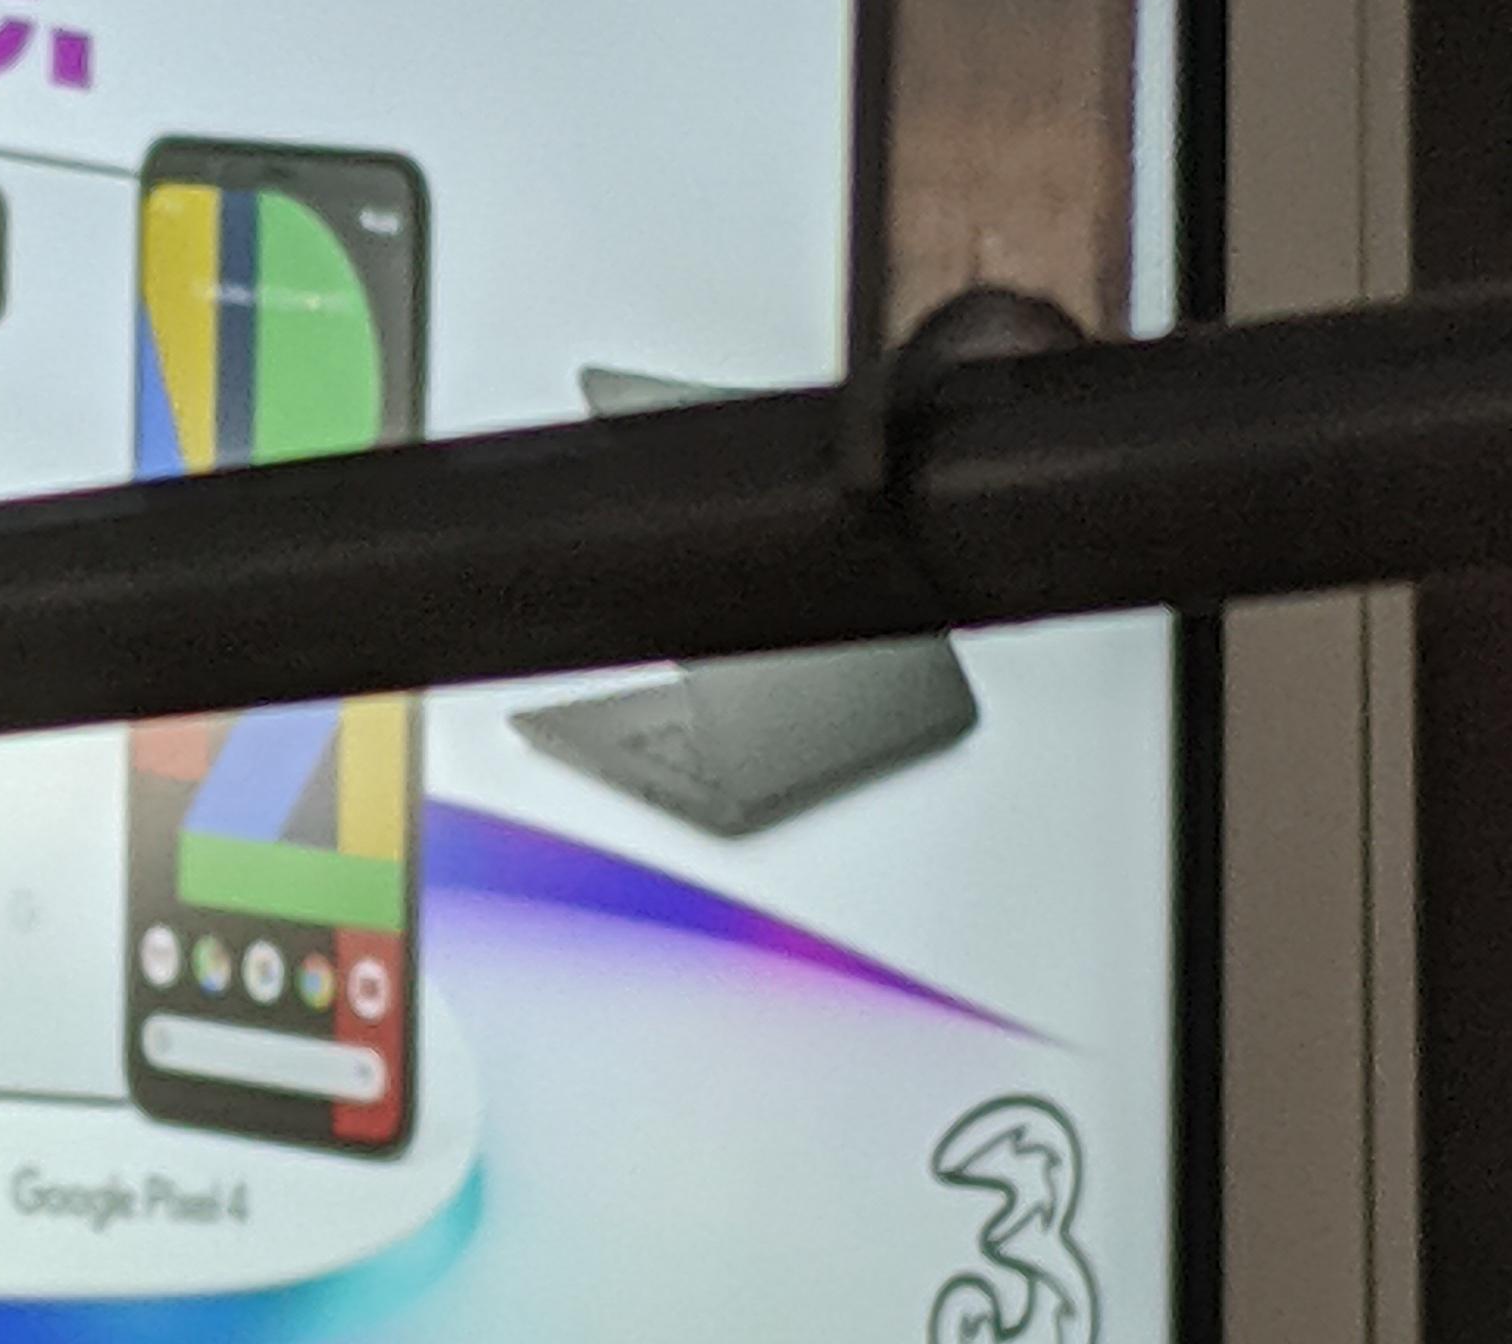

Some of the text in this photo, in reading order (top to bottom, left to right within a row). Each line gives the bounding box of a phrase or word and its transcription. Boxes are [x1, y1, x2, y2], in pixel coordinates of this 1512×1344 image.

[10, 1165, 251, 1233] Google Pixel 4
